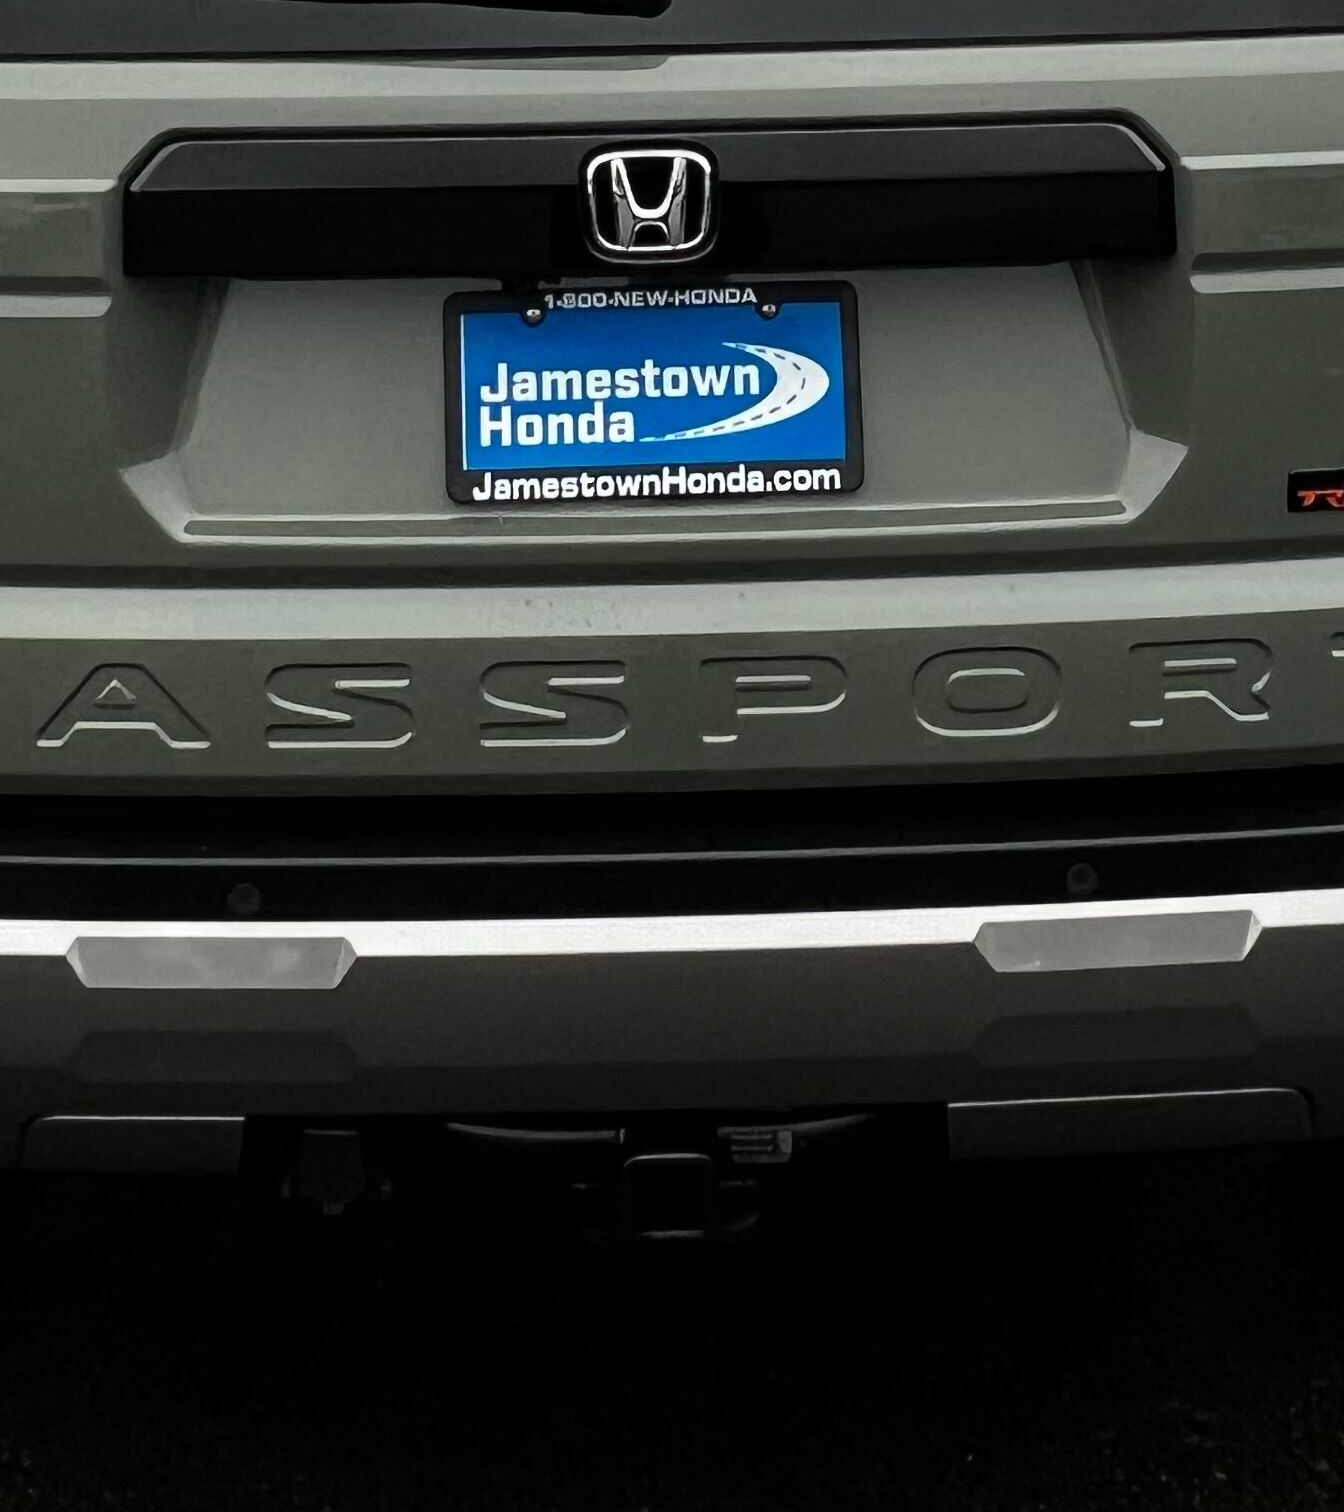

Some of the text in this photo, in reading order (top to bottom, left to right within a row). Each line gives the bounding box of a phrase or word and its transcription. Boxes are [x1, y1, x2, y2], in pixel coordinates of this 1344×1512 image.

[479, 359, 761, 404] Jamestown
[479, 399, 636, 447] Honda
[472, 465, 842, 501] JamestownHonda.com
